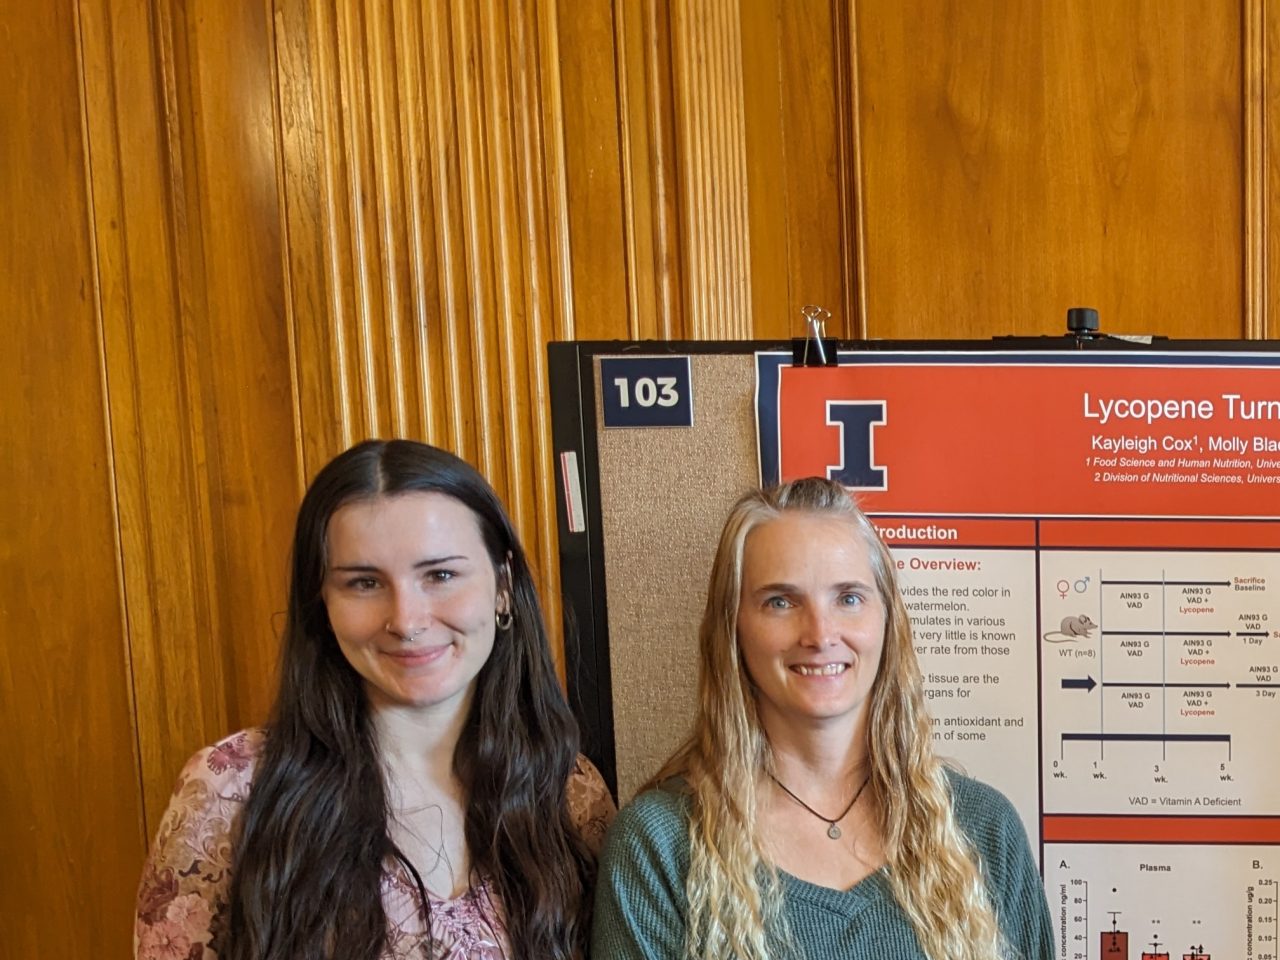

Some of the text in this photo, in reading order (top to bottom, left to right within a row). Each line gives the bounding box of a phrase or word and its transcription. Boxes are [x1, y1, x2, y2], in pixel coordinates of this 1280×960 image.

[614, 377, 679, 408] 103
[1084, 393, 1213, 425] Lycopene
[1092, 435, 1157, 454] Kayleigh
[1209, 436, 1248, 454] Molly
[1093, 457, 1117, 467] Food
[1119, 457, 1156, 467] Science
[1158, 458, 1176, 467] and
[1177, 458, 1210, 468] Human
[1213, 458, 1253, 469] Nutrition,
[1103, 472, 1139, 482] Division
[1140, 473, 1151, 482] of
[1152, 473, 1198, 482] Nutritional
[1200, 473, 1243, 484] Sciences,
[874, 524, 957, 540] roduction
[910, 557, 981, 571] Overview:
[932, 586, 1010, 597] the red color in
[904, 601, 970, 612] watermelon.
[954, 616, 1005, 626] in various
[919, 632, 942, 642] very
[945, 630, 966, 640] little
[970, 630, 978, 640] is
[981, 630, 1016, 641] known
[930, 645, 951, 654] rate
[954, 644, 978, 655] from
[981, 645, 1010, 655] those
[928, 673, 959, 683] tissue
[963, 675, 980, 684] are
[983, 674, 999, 684] the
[957, 687, 971, 698] for
[944, 716, 1001, 727] antioxidant
[1004, 717, 1023, 727] and
[944, 730, 955, 740] of
[957, 732, 986, 741] some
[1128, 796, 1241, 806] VAD Vitamin A Deficient
